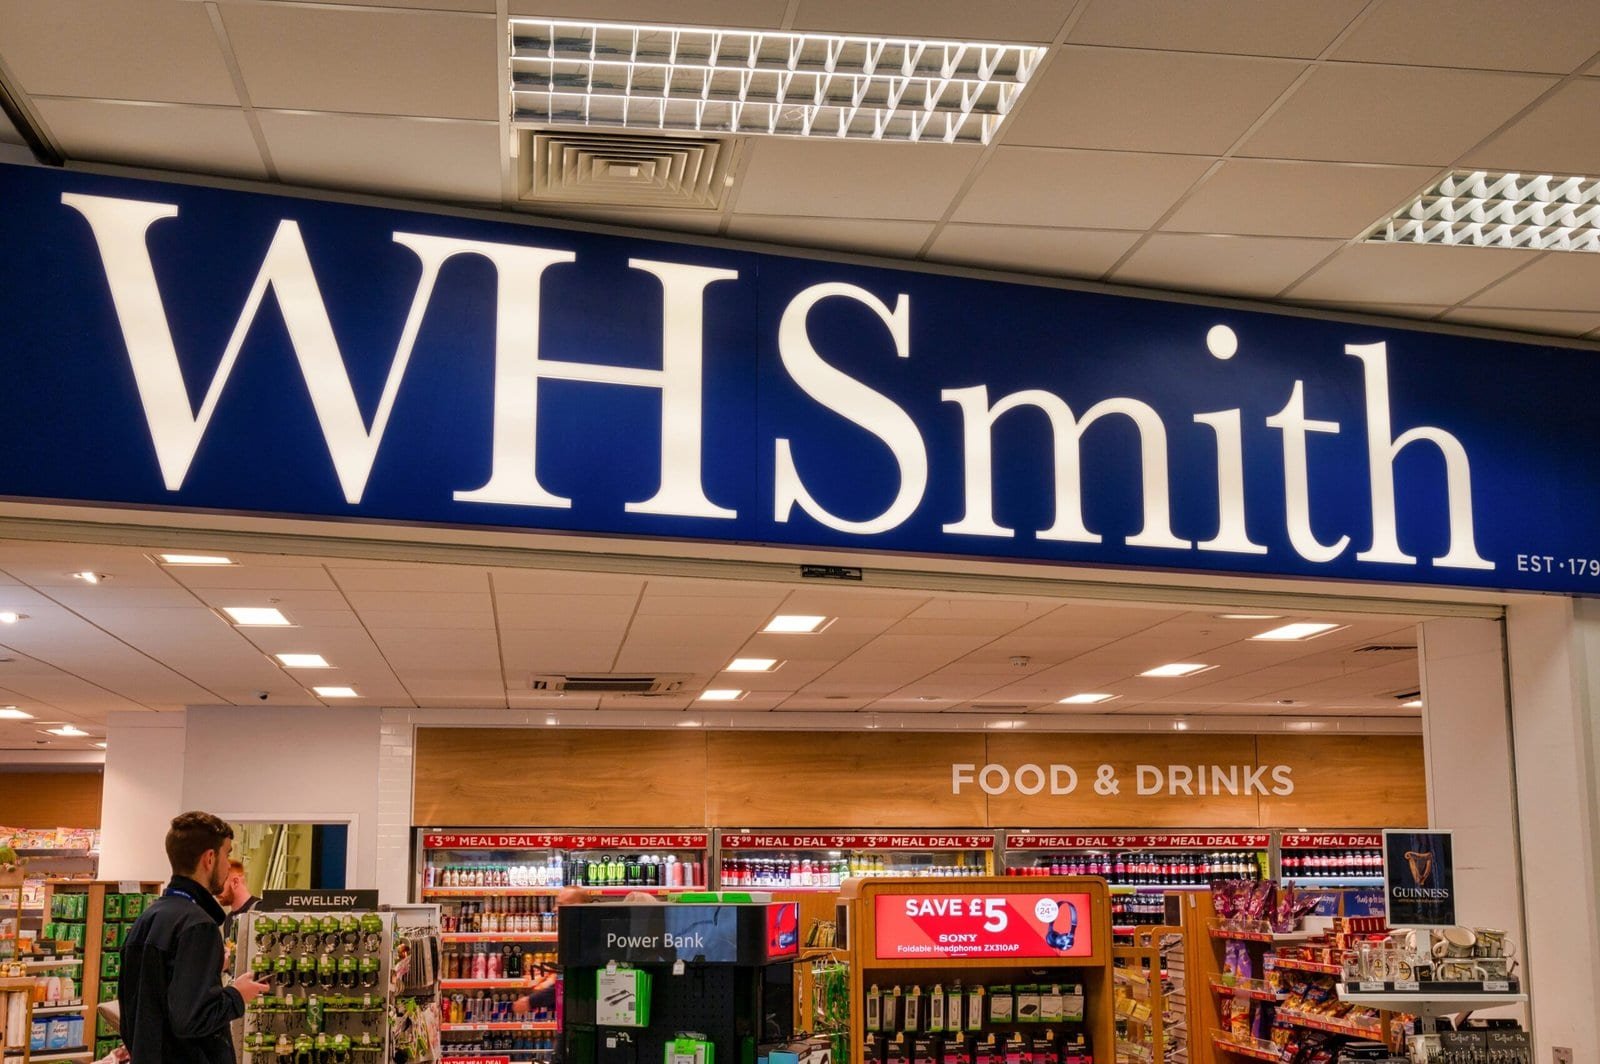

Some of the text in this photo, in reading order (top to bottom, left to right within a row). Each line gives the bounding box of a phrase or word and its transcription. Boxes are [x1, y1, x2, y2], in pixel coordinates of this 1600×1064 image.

[61, 190, 1496, 572] WHSmith
[952, 763, 1295, 797] FOOD & DRINKS
[459, 836, 495, 846] MEAL
[499, 836, 534, 846] DEAL
[600, 836, 637, 846] MEAL
[640, 836, 674, 846] DEAL
[755, 836, 790, 846] MEAL
[793, 836, 827, 846] DEAL
[891, 836, 926, 846] MEAL
[929, 836, 962, 846] DEAL
[1039, 836, 1073, 846] MEAL
[1076, 836, 1109, 846] DEAL
[1170, 836, 1206, 846] MEAL
[1208, 836, 1239, 846] DEAL
[1312, 836, 1345, 846] MEAL
[1348, 836, 1380, 846] DEAL
[1392, 886, 1450, 899] GUINNESS
[285, 895, 358, 906] JEWELLERY
[905, 897, 1009, 933] SAVE £5
[606, 931, 705, 949] Power Bank
[938, 934, 978, 943] SONY
[897, 943, 1020, 955] Foldable Headphones ZX310AP
